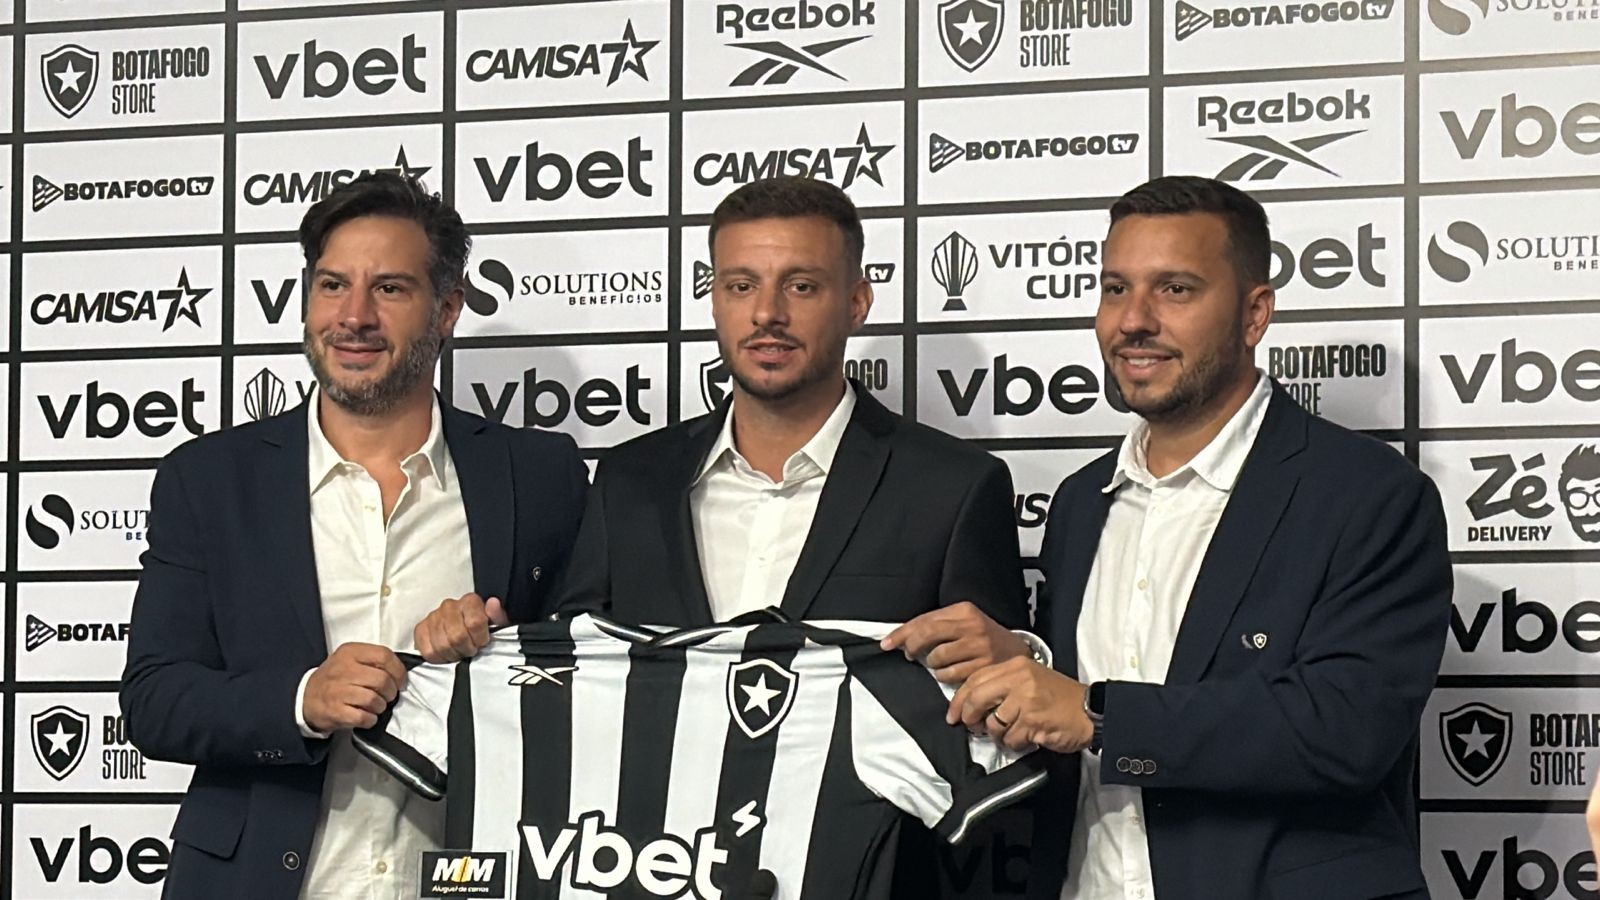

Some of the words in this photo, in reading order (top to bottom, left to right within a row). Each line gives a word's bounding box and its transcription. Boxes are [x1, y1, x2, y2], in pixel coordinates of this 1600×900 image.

[717, 0, 875, 38] Reebok
[1020, 0, 1132, 31] BOTAFOGO
[1213, 2, 1359, 28] BOTAFOGO
[112, 47, 210, 81] BOTAFOGO
[254, 34, 427, 100] vbet
[1020, 34, 1070, 67] STORE
[112, 83, 156, 114] STORE
[1198, 89, 1370, 132] Reebok
[1439, 93, 1600, 159] vbe
[965, 136, 1106, 160] BOTAFOGO
[473, 136, 653, 202] vbet
[64, 178, 185, 201] BOTAFOGO
[988, 236, 1105, 268] VITÓR
[1496, 236, 1600, 260] SOLUTI
[520, 270, 662, 296] SOLUTIONS
[1026, 273, 1097, 299] CUP
[1269, 343, 1386, 379] BOTAFOGO
[1439, 338, 1600, 404] vbe
[37, 378, 205, 439] vbet
[471, 364, 651, 427] vbet
[1466, 453, 1555, 521] Zé
[80, 510, 150, 530] SOLUT
[1468, 526, 1552, 542] DELIVERY
[57, 623, 130, 642] BOTAF
[1451, 587, 1600, 653] vbe
[1530, 714, 1600, 747] BOTAF
[103, 749, 146, 779] STORE
[1530, 752, 1586, 785] STORE
[29, 824, 170, 884] vbe
[522, 816, 729, 900] vbet
[1441, 836, 1600, 900] vbe
